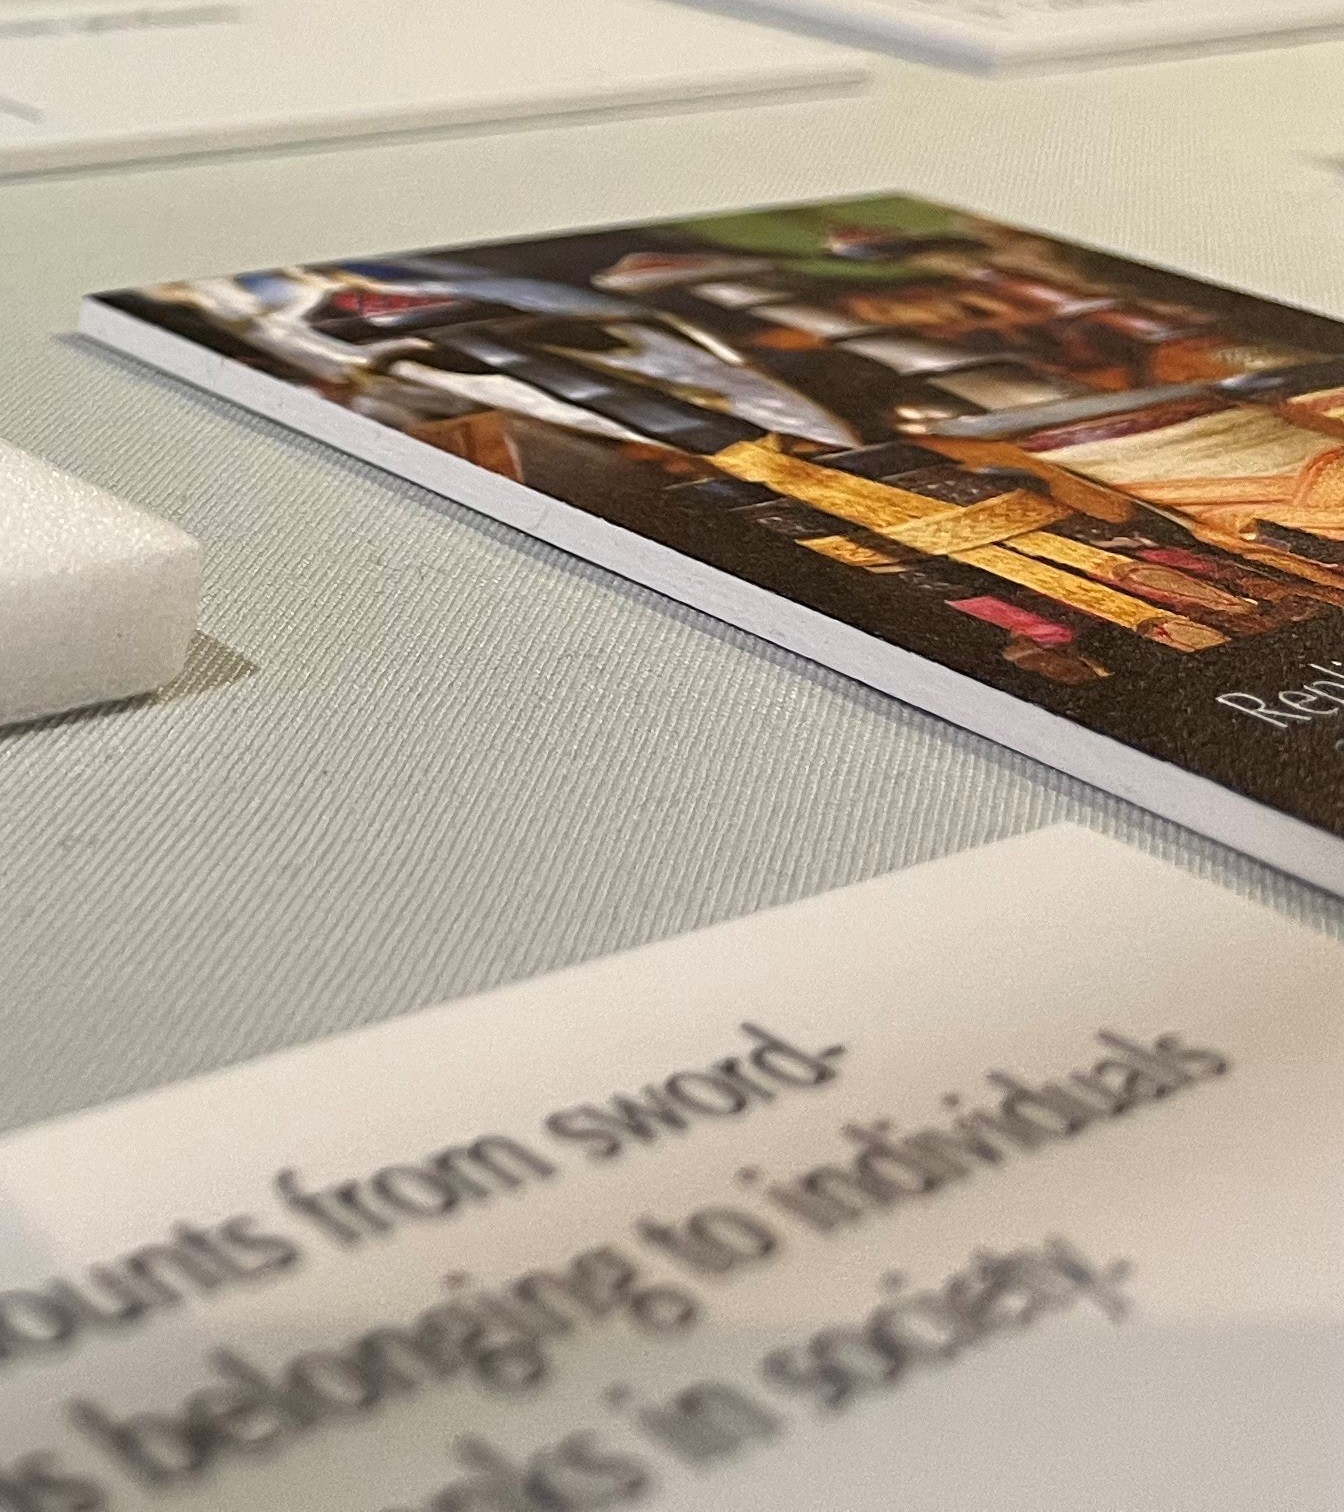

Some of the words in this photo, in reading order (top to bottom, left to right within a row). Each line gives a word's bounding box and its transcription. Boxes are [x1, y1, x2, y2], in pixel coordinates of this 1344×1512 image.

[1215, 660, 1344, 729] Rep
[272, 1131, 557, 1248] from
[544, 1020, 847, 1162] sword-
[64, 1242, 702, 1491] belonging
[632, 1204, 780, 1280] to
[733, 1026, 1233, 1236] individuals
[760, 1234, 1138, 1413] society.
